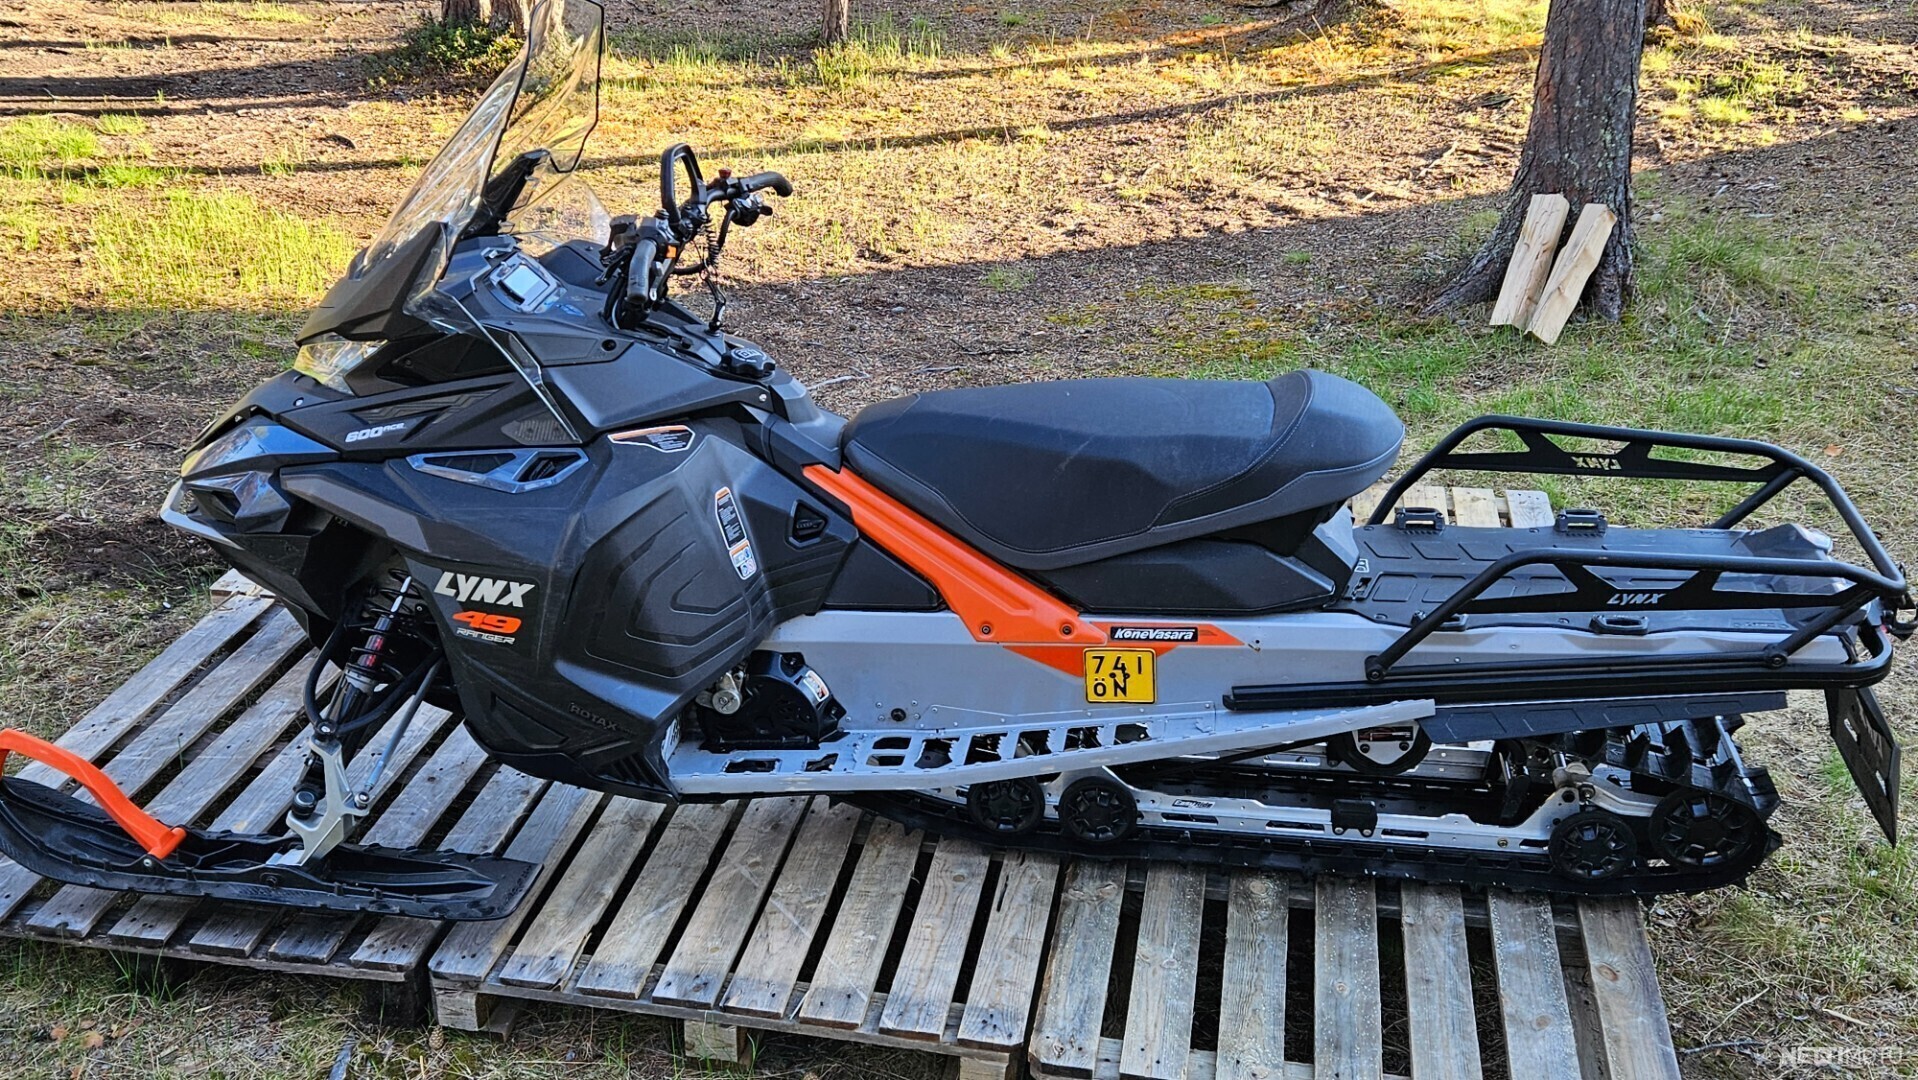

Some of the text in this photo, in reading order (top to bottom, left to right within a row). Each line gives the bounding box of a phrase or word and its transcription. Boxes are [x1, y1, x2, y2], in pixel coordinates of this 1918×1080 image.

[345, 426, 383, 442] 600
[433, 571, 535, 608] LYNX
[1606, 593, 1667, 605] LYNX
[452, 611, 522, 634] 49
[456, 627, 516, 645] RANGER
[1114, 628, 1195, 640] KoneVasara
[569, 703, 617, 731] ROTAX
